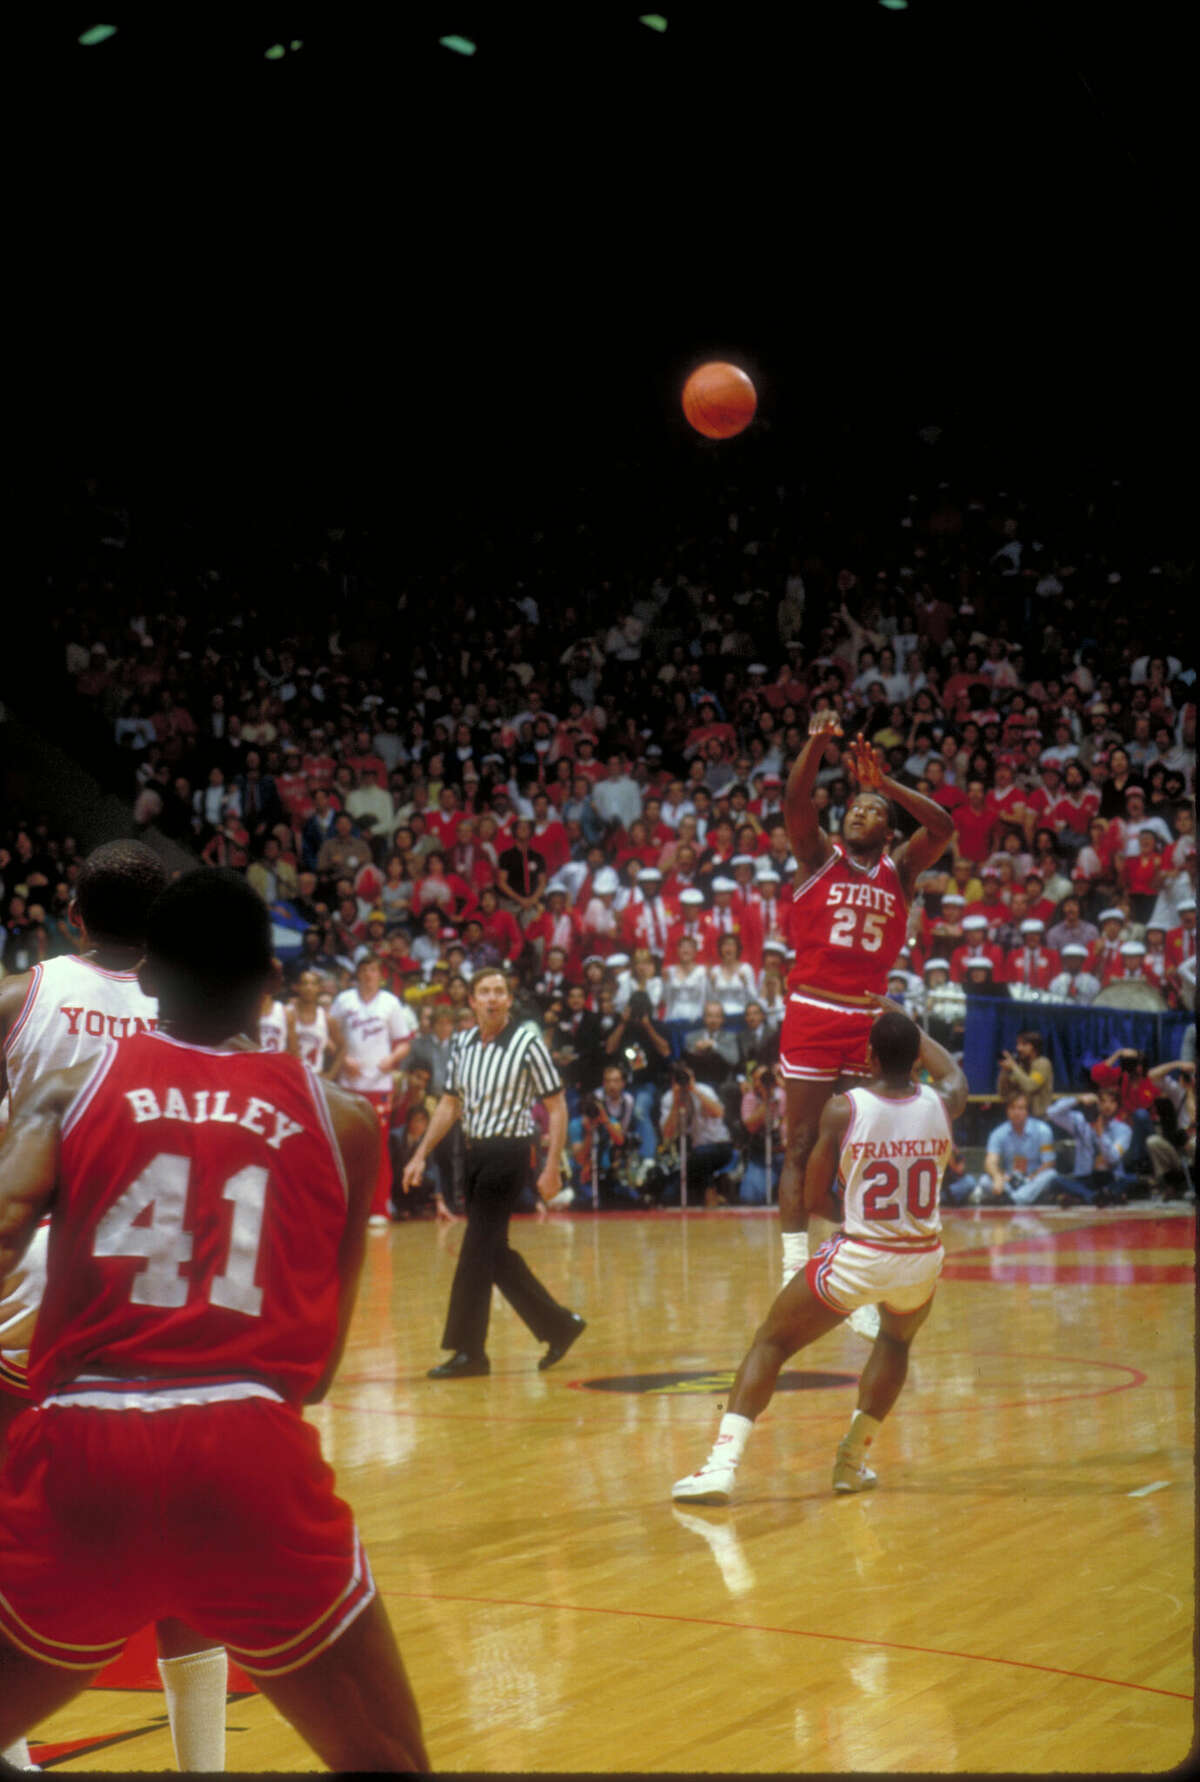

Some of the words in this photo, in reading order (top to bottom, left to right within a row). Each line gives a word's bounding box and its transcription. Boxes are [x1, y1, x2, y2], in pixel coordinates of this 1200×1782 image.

[826, 883, 896, 917] STATE
[829, 908, 887, 952] 25
[126, 1087, 303, 1149] BAILEY
[851, 1138, 950, 1160] FRANKLIN
[863, 1158, 937, 1220] 20
[93, 1153, 270, 1317] 41
